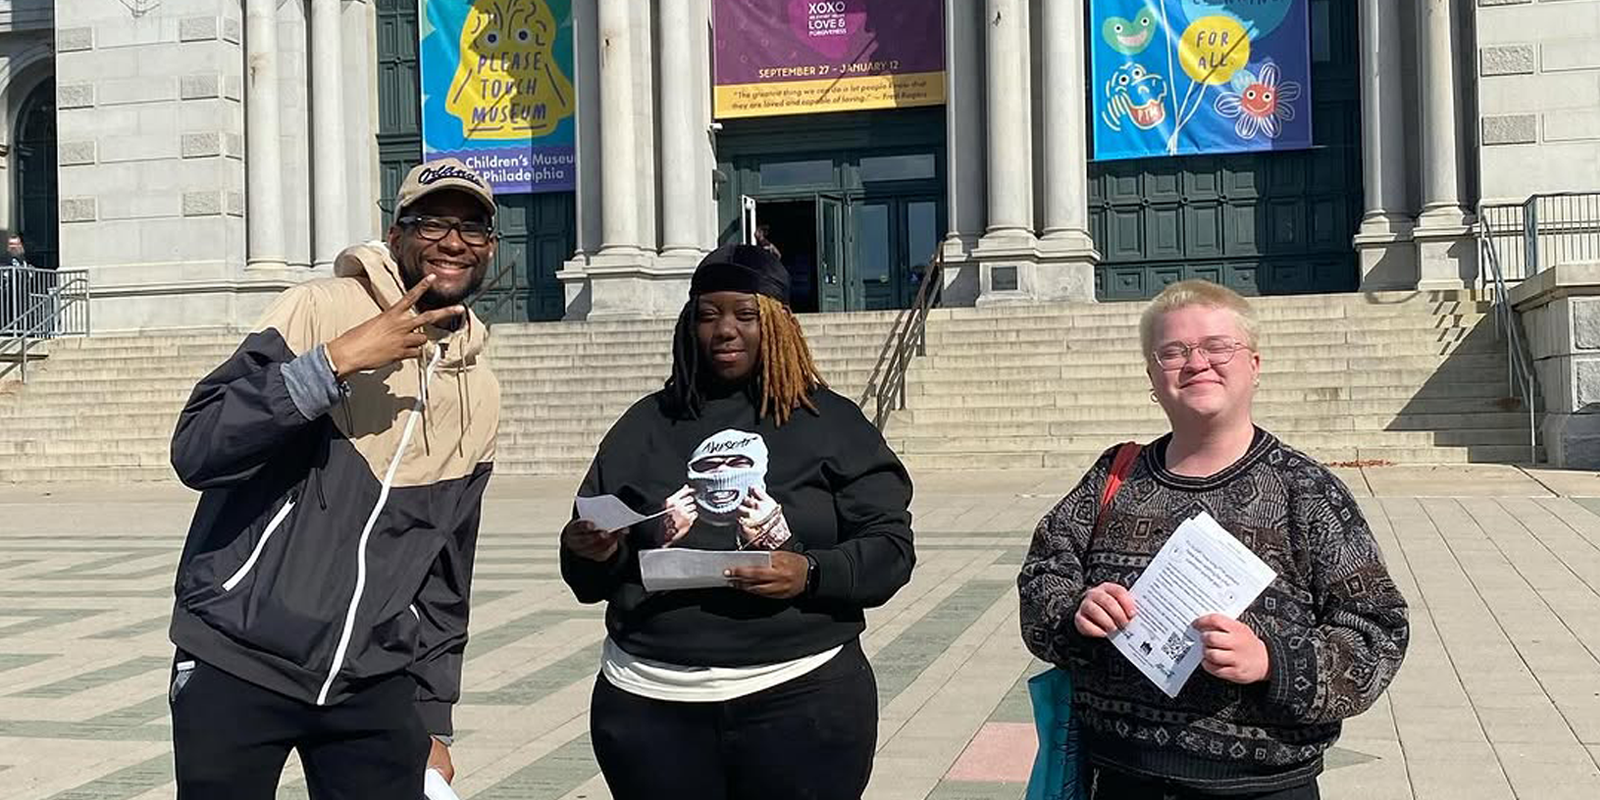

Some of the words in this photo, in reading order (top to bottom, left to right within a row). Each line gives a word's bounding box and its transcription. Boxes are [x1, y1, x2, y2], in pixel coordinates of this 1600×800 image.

[808, 1, 846, 14] XOXO
[808, 19, 836, 29] LOVE
[838, 18, 846, 27] &
[808, 29, 847, 37] FORGIVENESS
[1196, 31, 1229, 47] FOR
[477, 52, 542, 75] PLEASE
[759, 66, 816, 78] SEPTEMBER
[818, 65, 830, 75] 27
[840, 61, 886, 73] JANUARY
[889, 60, 900, 69] 12
[481, 78, 537, 100] TOUCH
[472, 103, 547, 124] MUSEUM
[465, 154, 529, 169] Children's
[532, 153, 574, 166] Museu
[483, 166, 564, 184] Philadelphia
